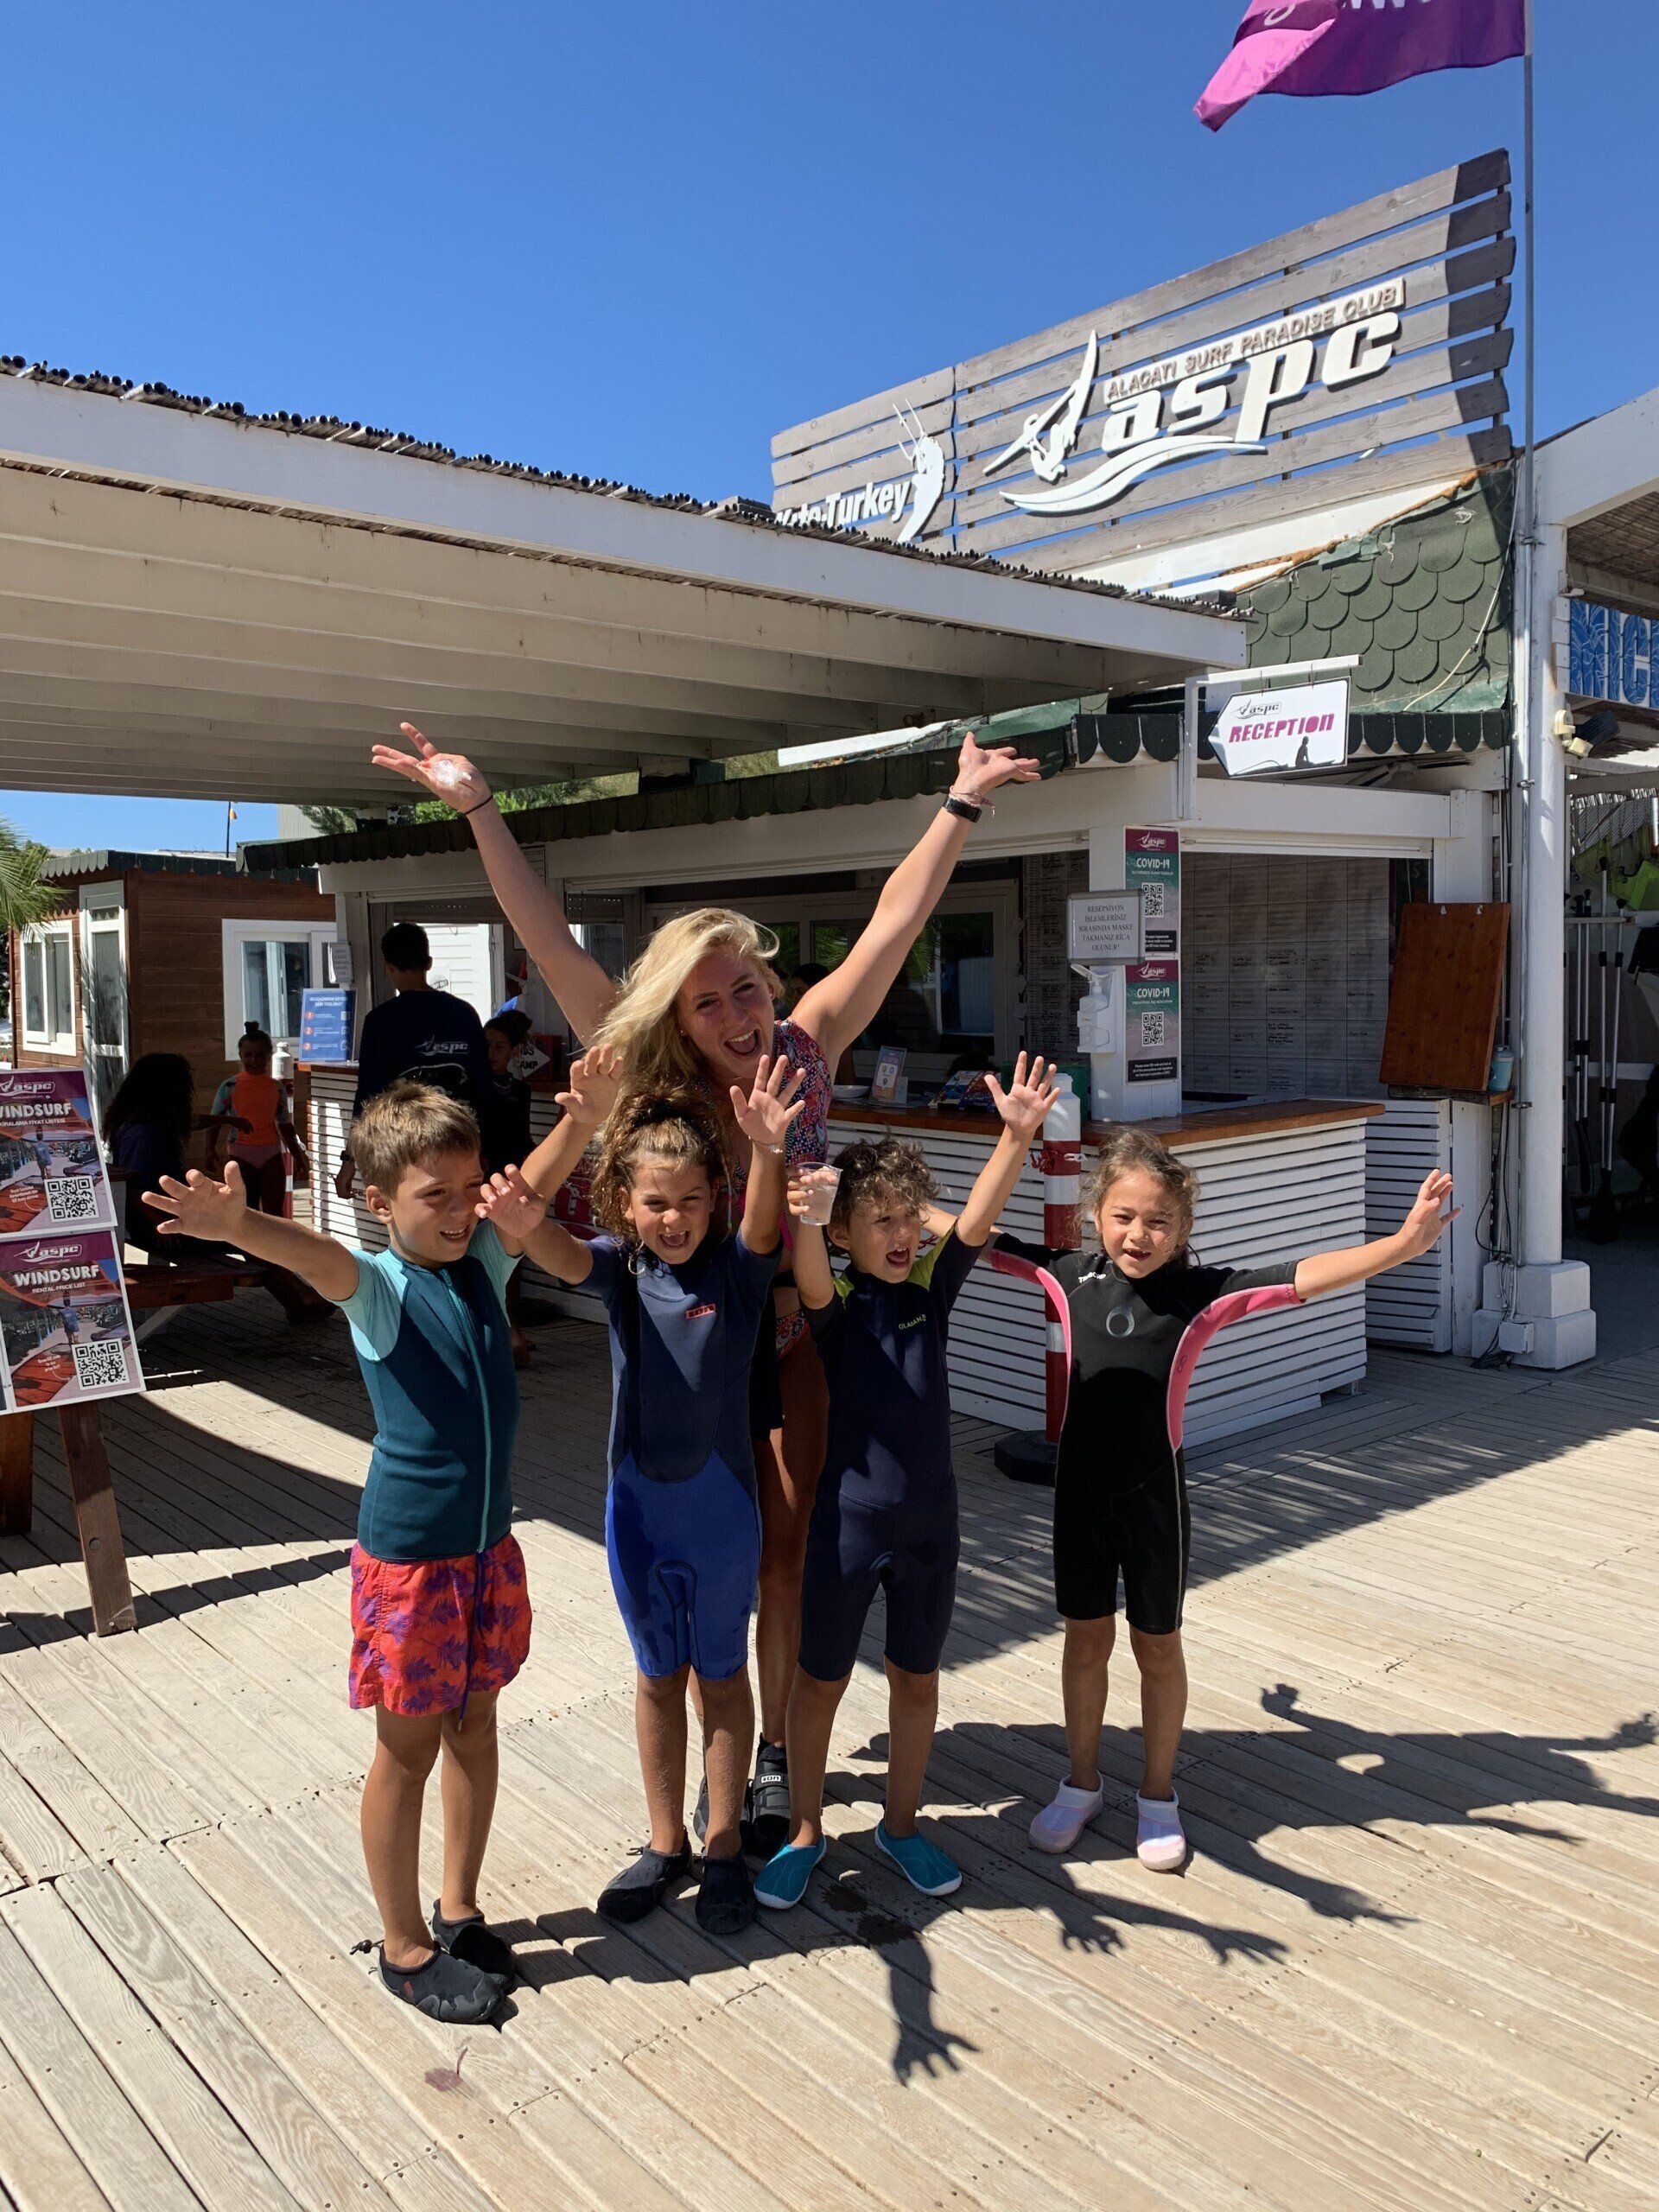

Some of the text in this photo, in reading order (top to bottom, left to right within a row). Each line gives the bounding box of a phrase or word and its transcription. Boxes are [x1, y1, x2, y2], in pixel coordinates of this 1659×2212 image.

[1185, 341, 1232, 373] SURF
[1242, 306, 1336, 353] PARADISE
[1344, 286, 1396, 319] CLUB
[1102, 312, 1399, 452] aspc
[1249, 703, 1280, 715] aspc
[1229, 713, 1335, 743] RECEPTION
[1136, 857, 1170, 869] COVID-19
[1136, 987, 1170, 998] COVID-19
[13, 1082, 53, 1093] aspc
[39, 1246, 79, 1257] aspc
[13, 1264, 99, 1287] WINDSURF
